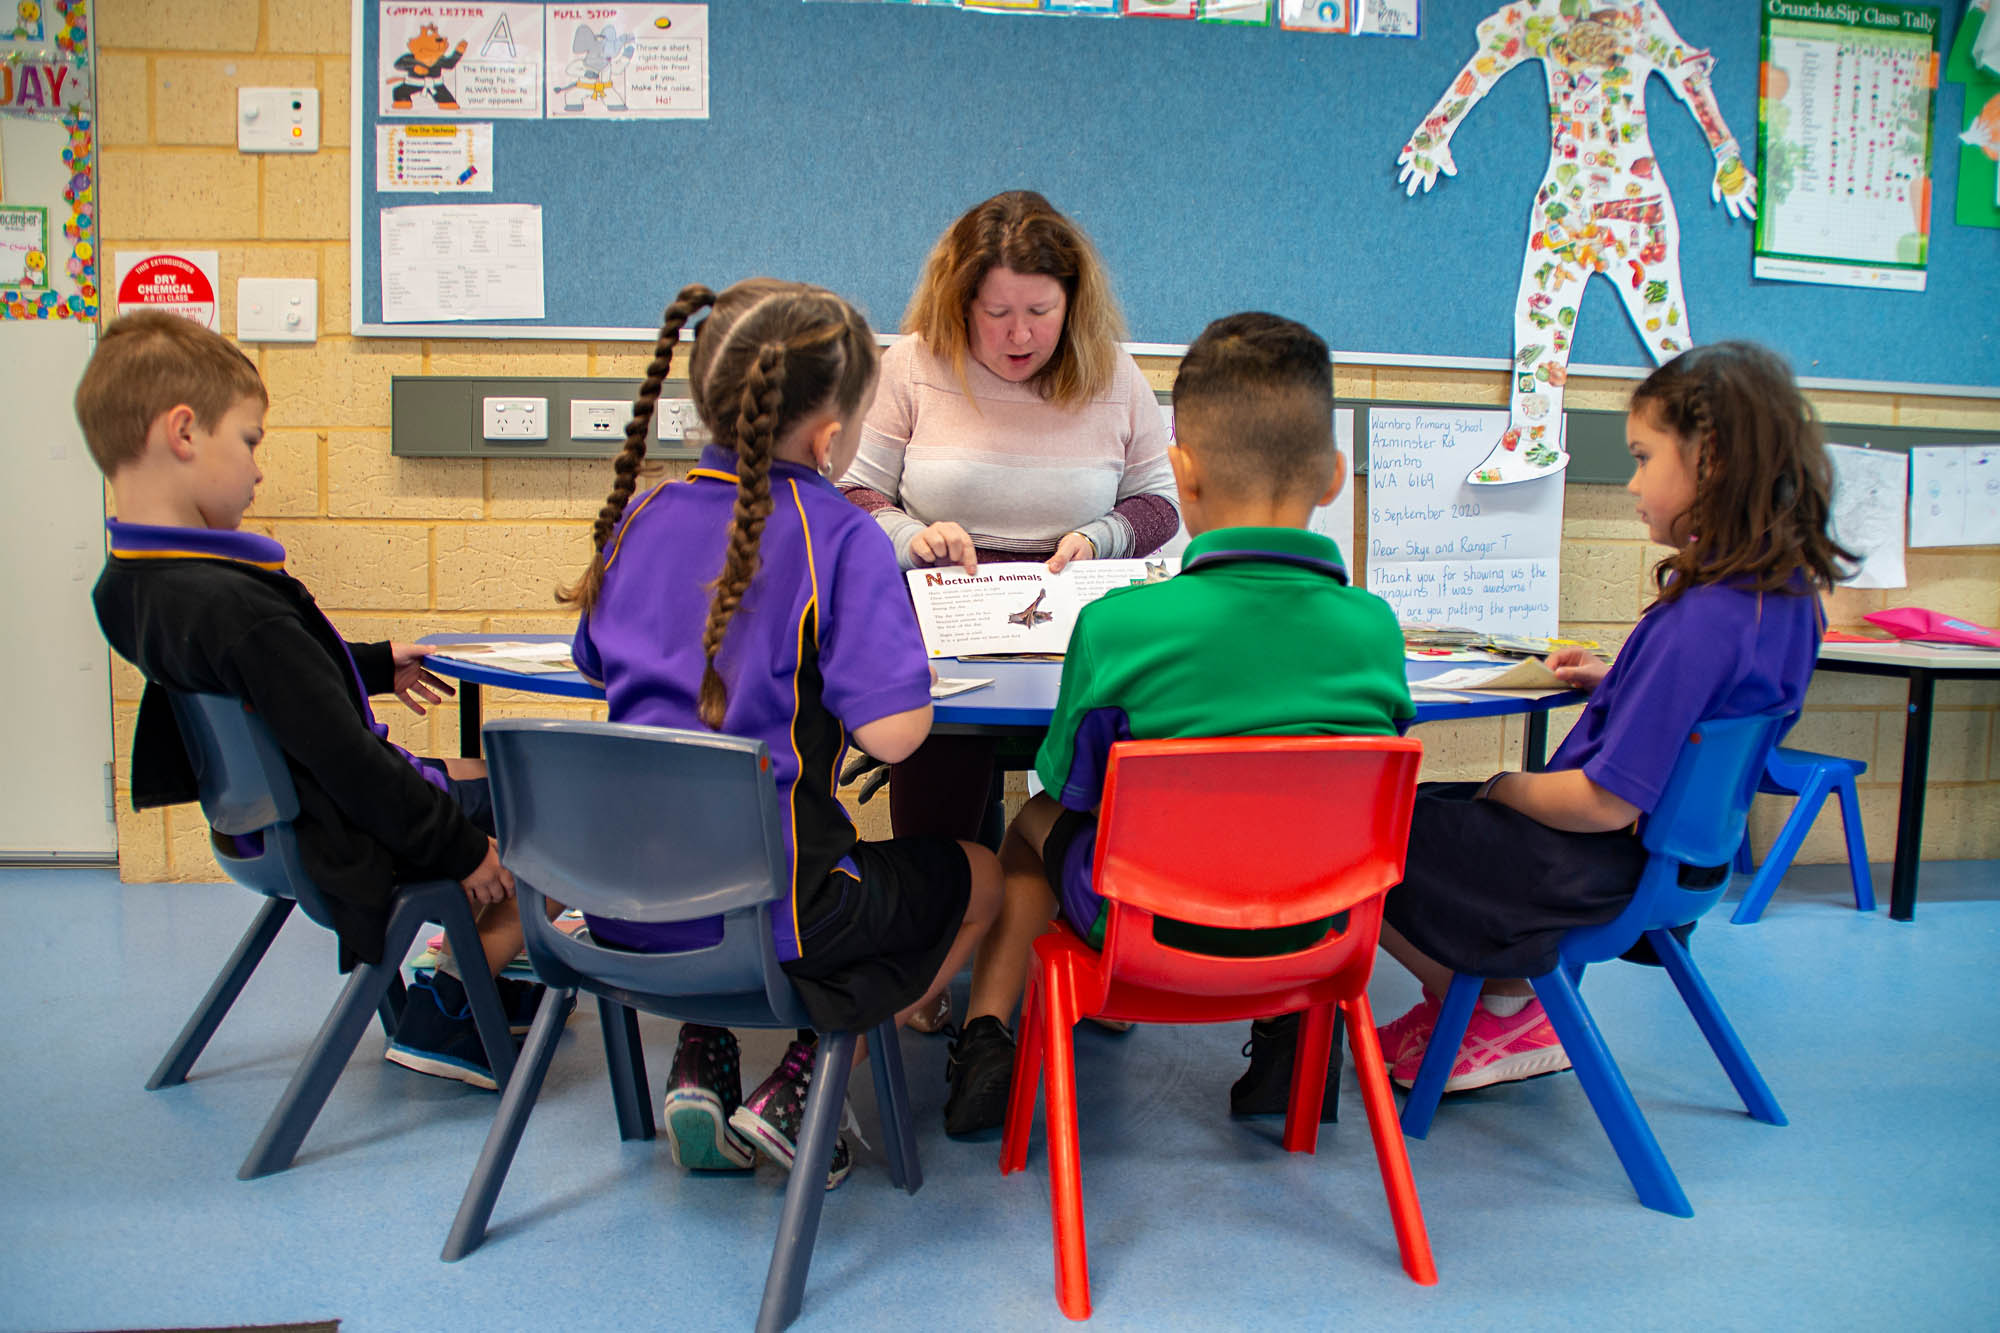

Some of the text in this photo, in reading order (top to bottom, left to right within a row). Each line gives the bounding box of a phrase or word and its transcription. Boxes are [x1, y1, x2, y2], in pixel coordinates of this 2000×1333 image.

[386, 7, 484, 18] CAPITAL LETTER
[553, 9, 617, 20] FULL STOP
[1863, 8, 1900, 26] Class
[1903, 11, 1936, 32] Tally
[480, 11, 517, 58] A
[669, 43, 690, 52] short
[463, 65, 476, 73] The
[480, 65, 496, 74] first
[671, 63, 690, 71] front
[465, 86, 498, 95] ALWAYS
[631, 84, 651, 92] Make
[655, 84, 668, 92] the
[655, 95, 672, 105] Ha!
[135, 257, 195, 275] THIS EXTINGUISHER
[154, 274, 177, 284] DRY
[137, 284, 194, 295] CHEMICAL
[1371, 415, 1483, 434] Warnbro Primary School
[1442, 433, 1456, 448] Rd
[1372, 453, 1423, 470] Warnbro
[1408, 472, 1435, 489] 6169
[1371, 503, 1481, 528] 8 September 2020
[1372, 538, 1399, 557] Dear
[1435, 541, 1454, 555] and
[1460, 535, 1497, 560] Ranger
[925, 572, 1043, 588] Nocturnal Animals
[1373, 562, 1547, 588] Thank you for showing us the
[1451, 584, 1473, 596] was
[1406, 606, 1427, 617] are
[1426, 608, 1442, 622] you
[1448, 603, 1484, 622] putting
[1490, 602, 1504, 615] the
[1508, 602, 1550, 621] penguins
